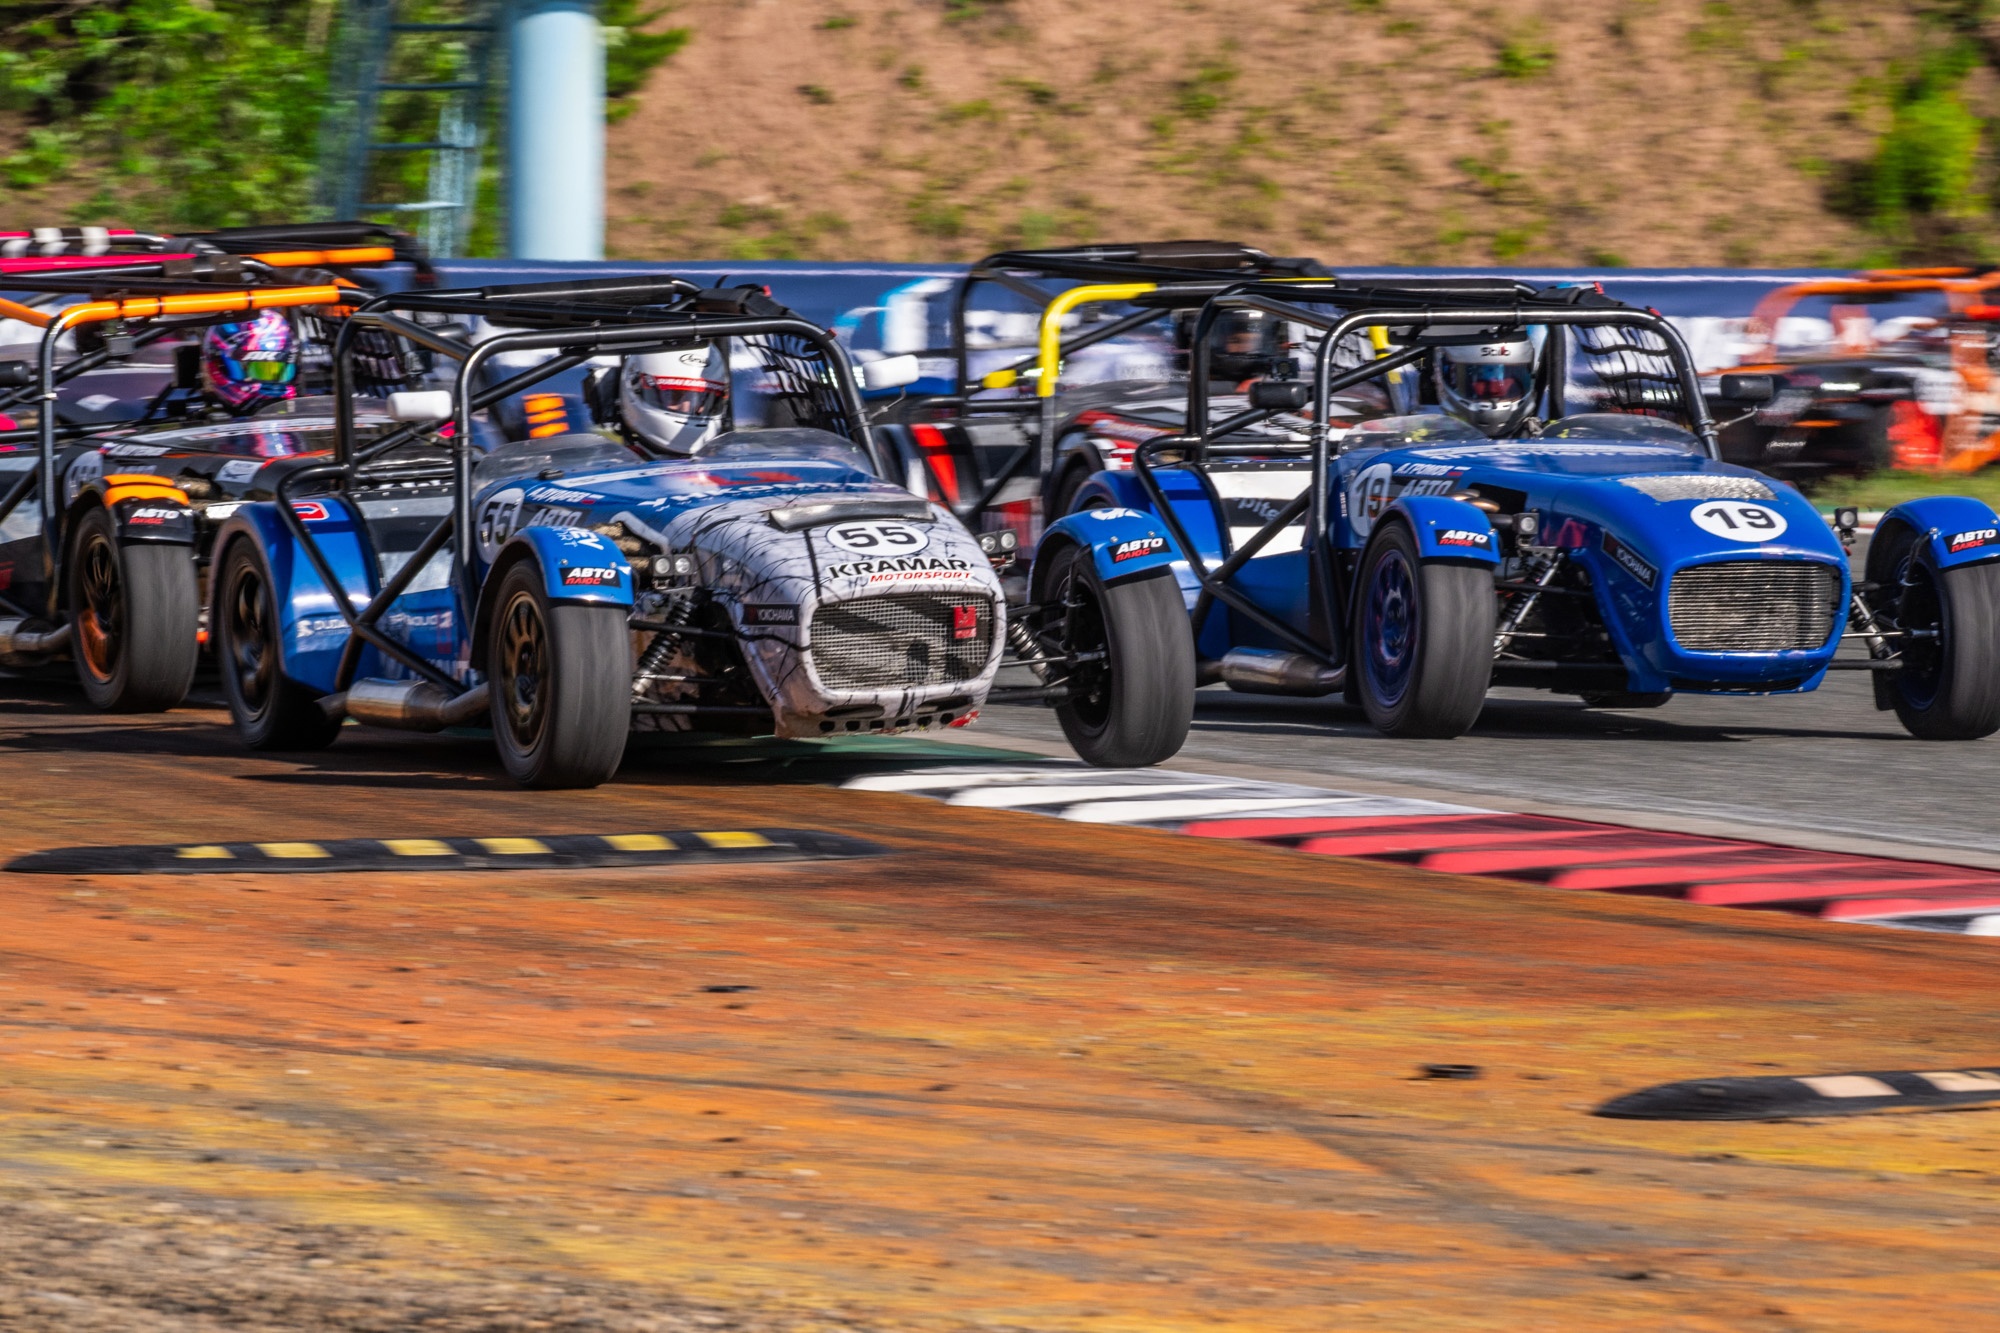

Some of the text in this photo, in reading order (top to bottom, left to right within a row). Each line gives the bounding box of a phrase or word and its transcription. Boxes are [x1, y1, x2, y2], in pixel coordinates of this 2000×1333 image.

[1355, 476, 1387, 518] 19
[479, 501, 518, 545] 55
[1703, 508, 1777, 530] 19
[836, 525, 917, 548] 55
[1116, 537, 1164, 555] АВТО
[1441, 529, 1489, 544] АВТО
[1951, 528, 1997, 546] АВТО
[566, 567, 617, 579] АВТО
[828, 558, 972, 579] KRAMAR
[869, 570, 973, 583] MOTORSPORT
